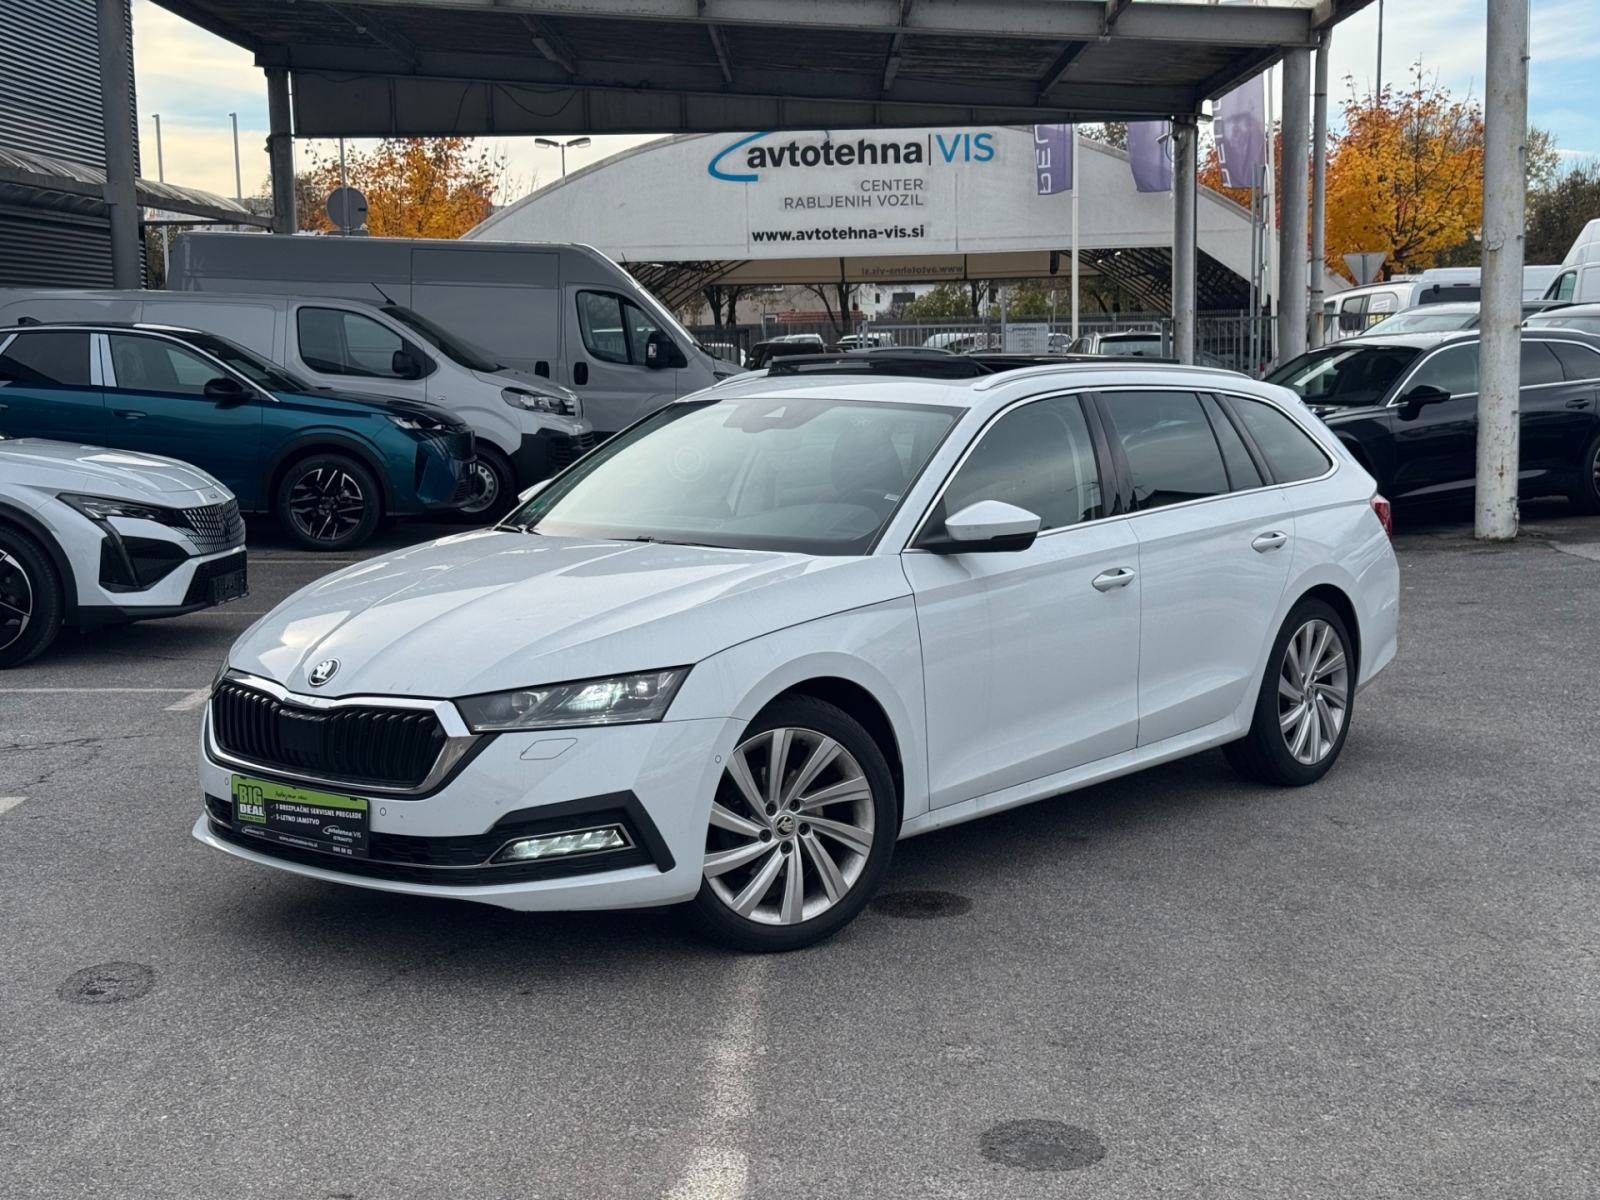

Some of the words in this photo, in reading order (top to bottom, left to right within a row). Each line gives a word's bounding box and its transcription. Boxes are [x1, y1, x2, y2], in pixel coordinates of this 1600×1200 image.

[747, 138, 923, 168] avtotehna
[936, 133, 994, 162] VIS
[861, 179, 924, 192] CENTER
[784, 195, 872, 209] RABLJENIH
[877, 194, 924, 207] VOZIL
[752, 225, 925, 242] www.avtotehna-vis.si
[238, 784, 263, 806] BIG
[240, 803, 264, 817] DEAL
